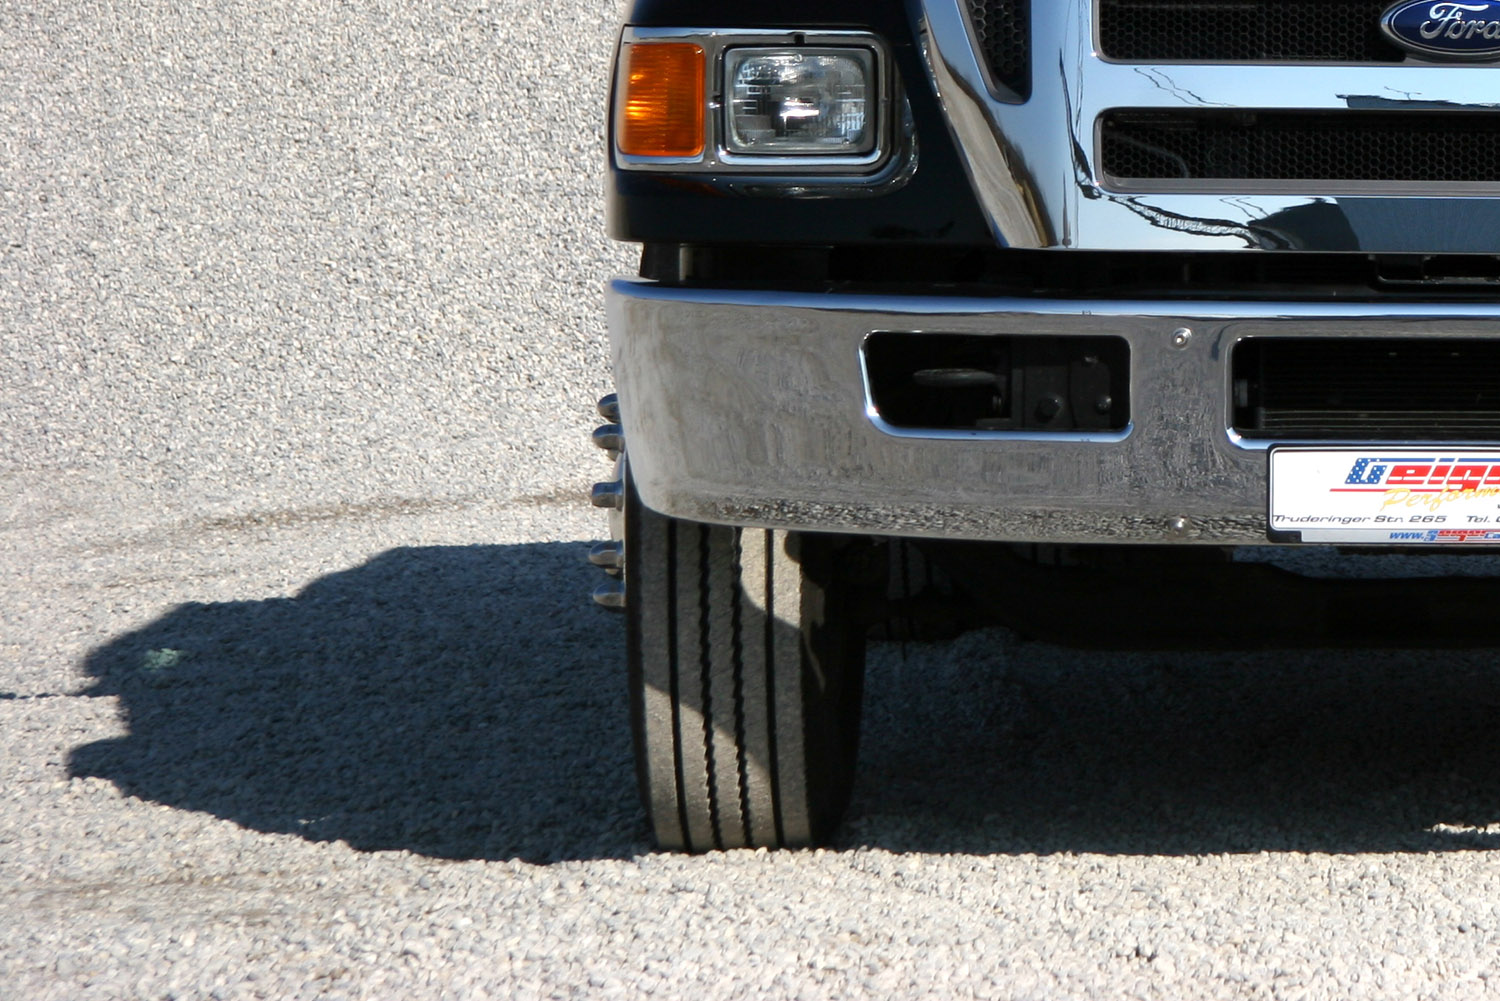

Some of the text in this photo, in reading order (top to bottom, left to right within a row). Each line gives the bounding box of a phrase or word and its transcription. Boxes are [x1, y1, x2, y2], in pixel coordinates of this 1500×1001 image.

[1272, 514, 1371, 525] Truderinger
[1408, 514, 1448, 523] 265
[1466, 514, 1491, 523] Tel.
